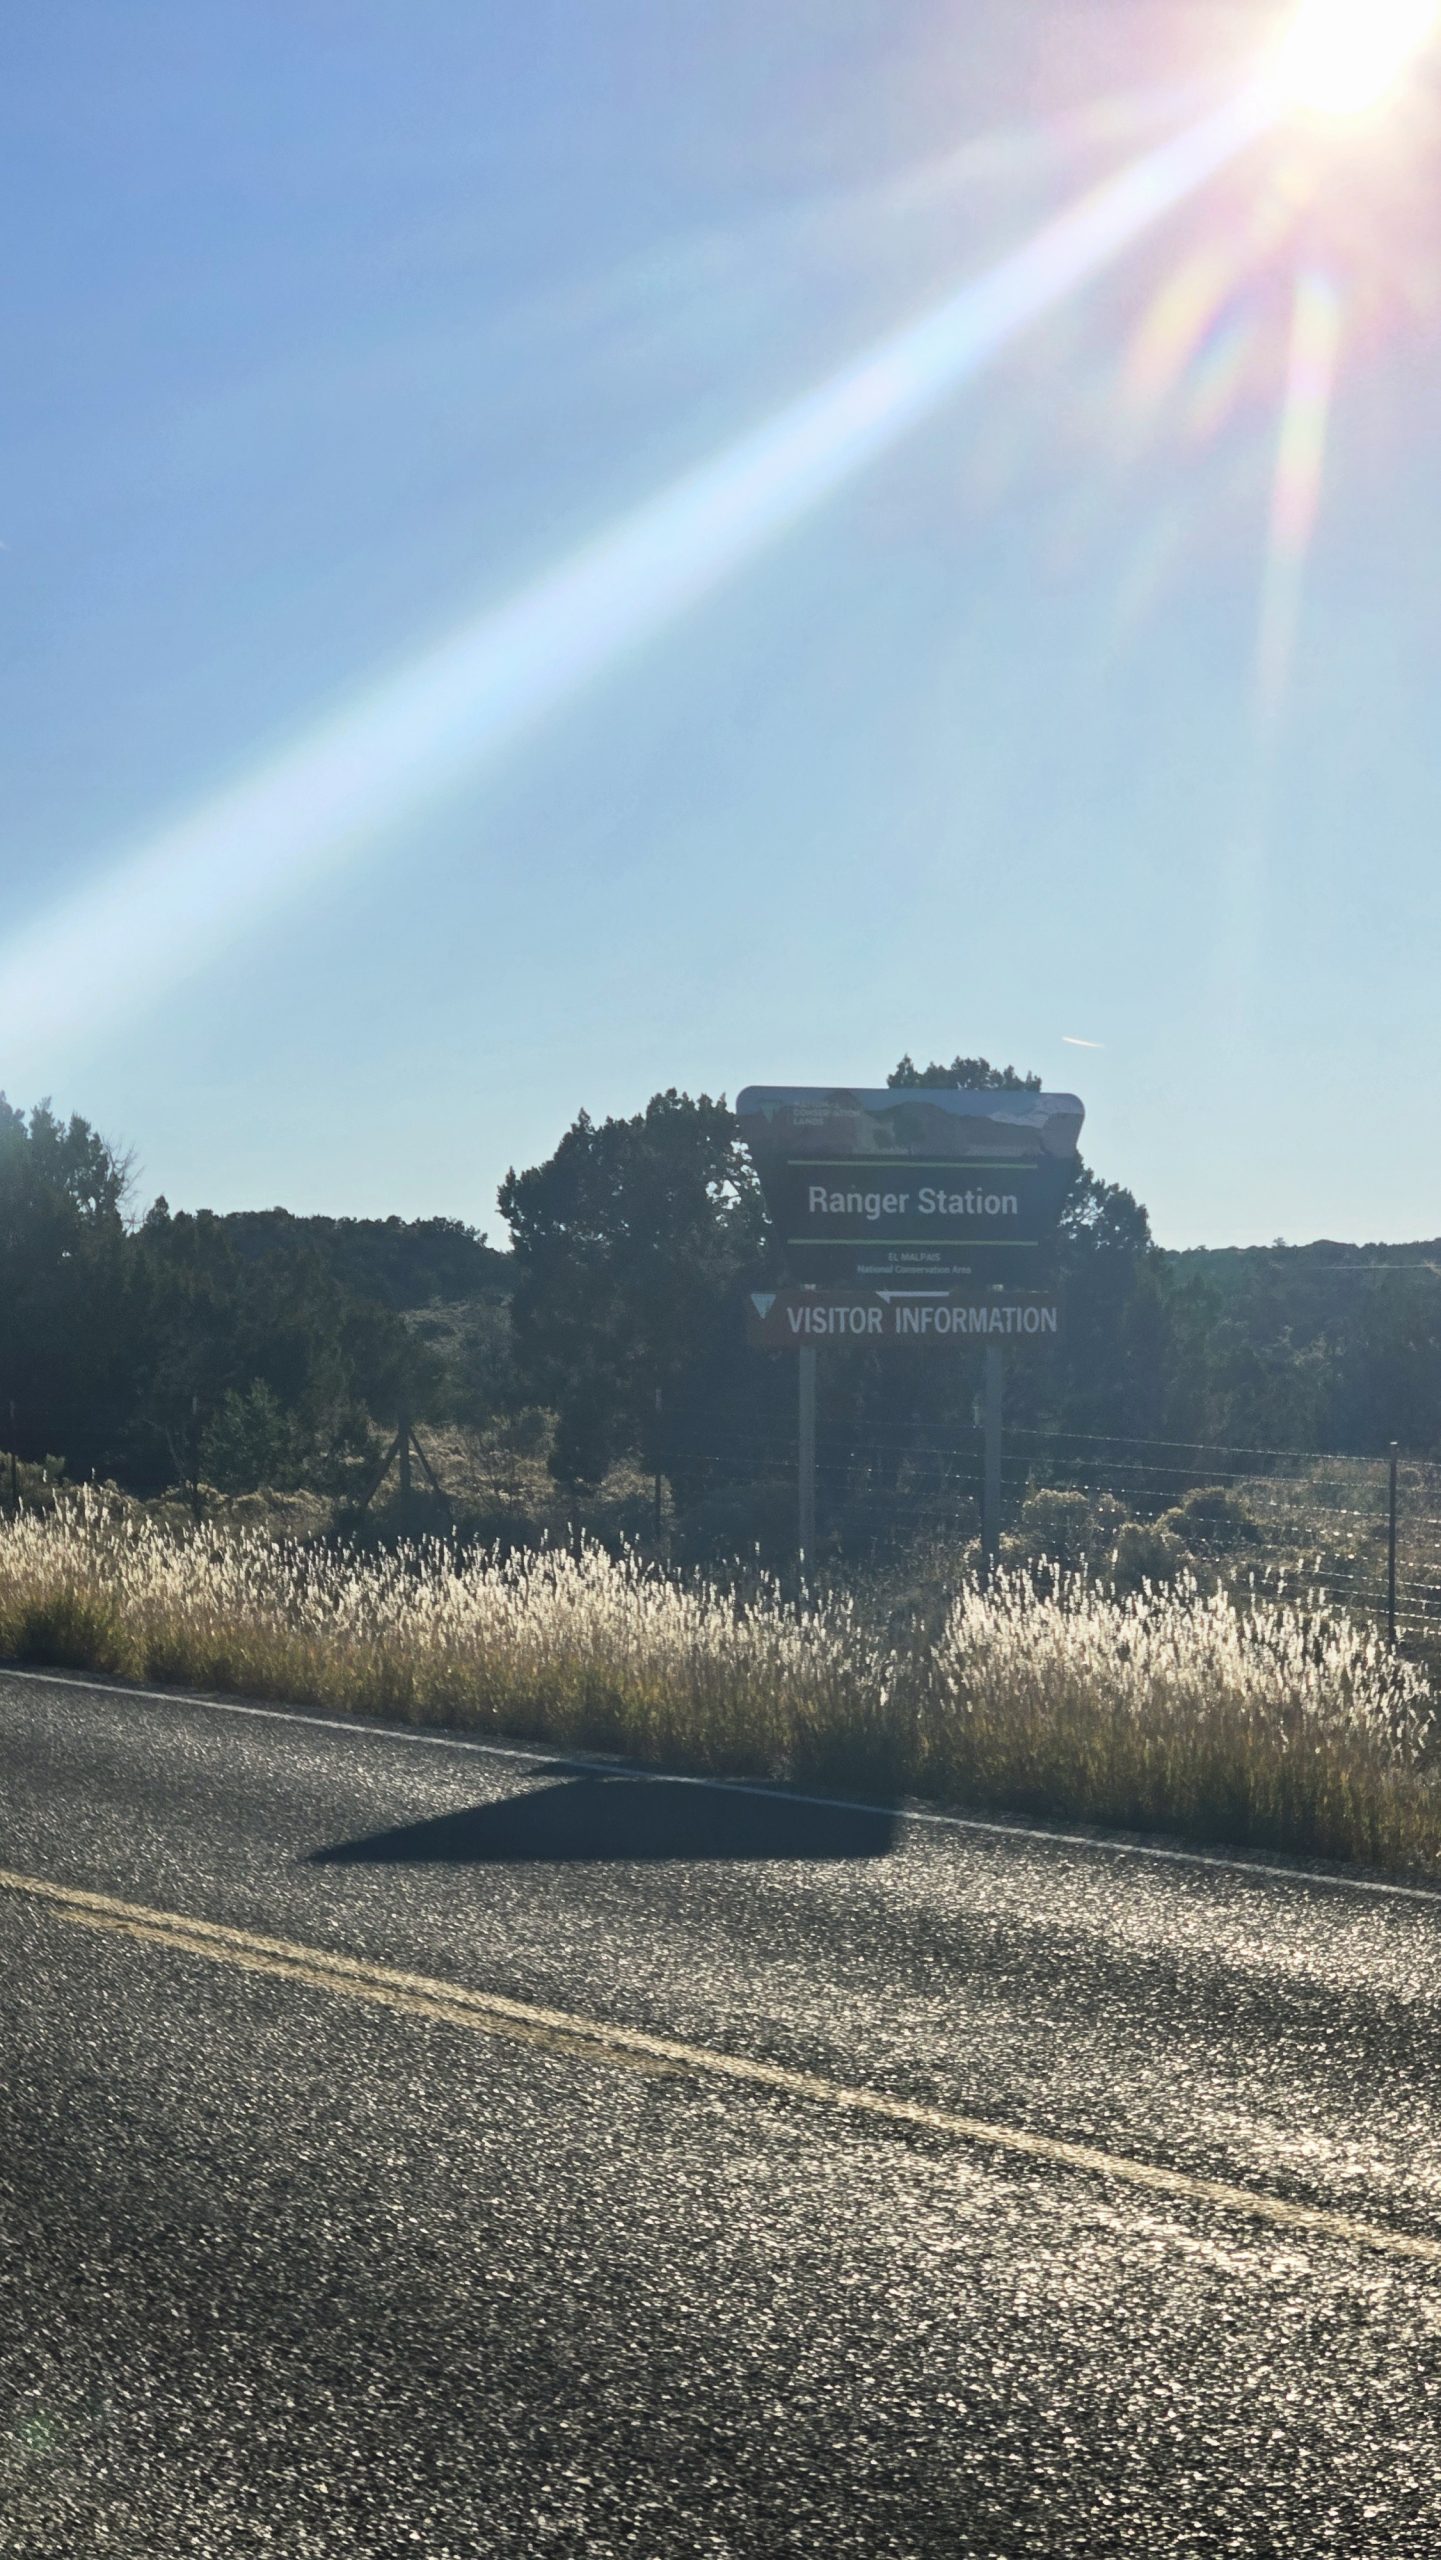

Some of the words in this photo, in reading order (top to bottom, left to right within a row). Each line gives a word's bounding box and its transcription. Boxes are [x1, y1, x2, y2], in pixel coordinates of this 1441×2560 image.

[808, 1186, 910, 1220] Ranger
[918, 1186, 1018, 1215] Station
[786, 1306, 883, 1333] VISITOR
[896, 1306, 1058, 1333] INFORMATION
